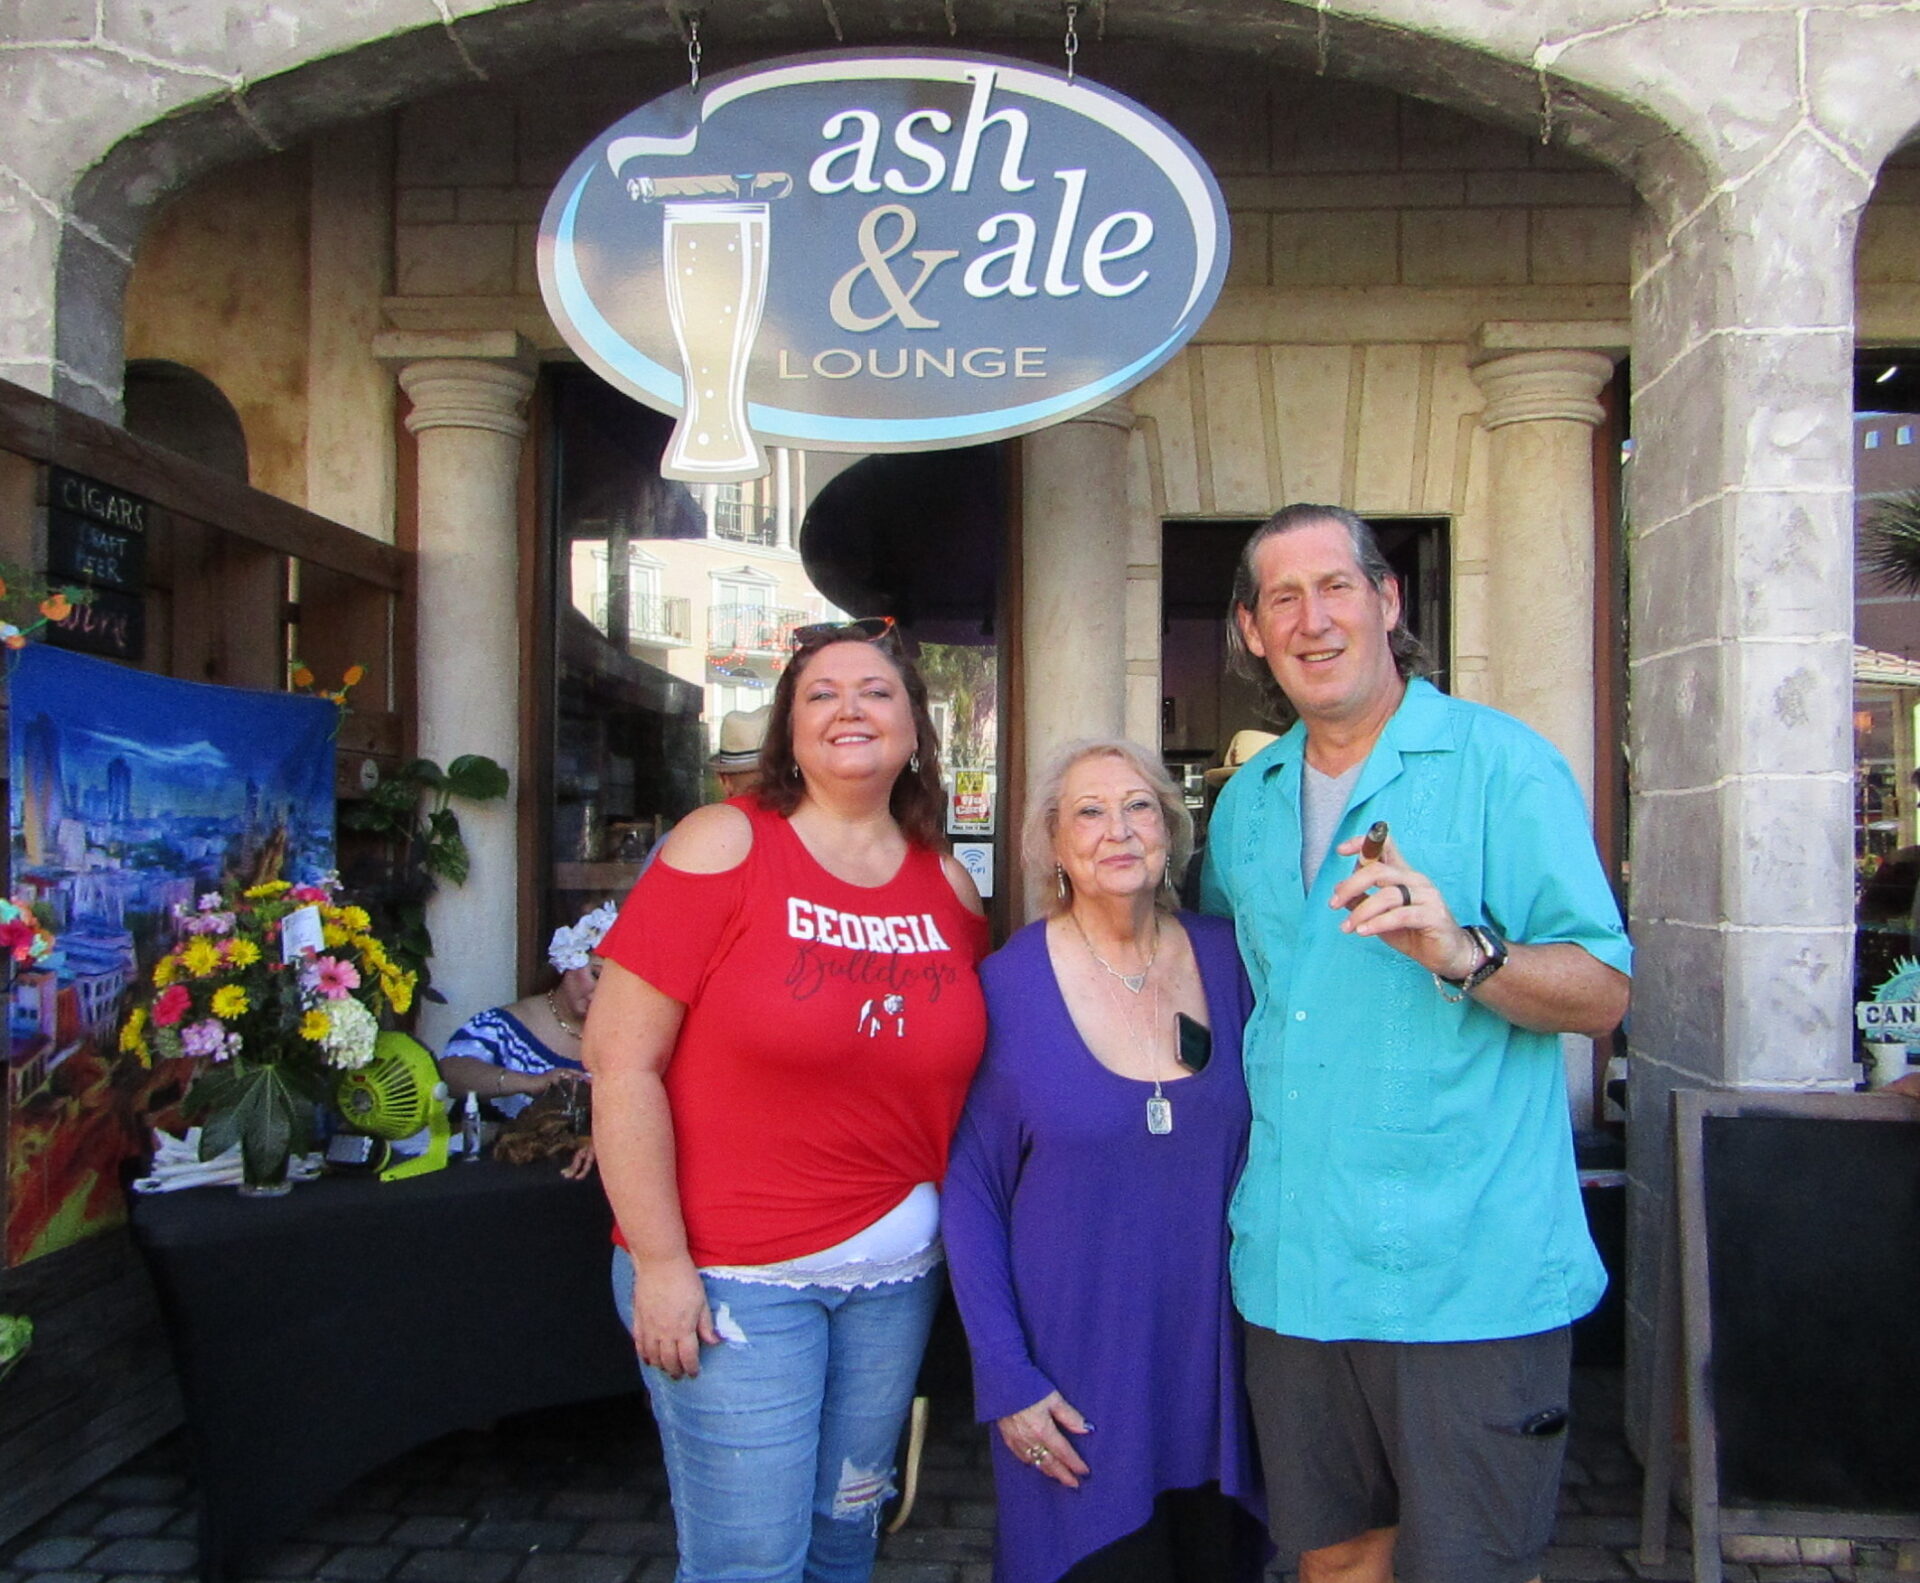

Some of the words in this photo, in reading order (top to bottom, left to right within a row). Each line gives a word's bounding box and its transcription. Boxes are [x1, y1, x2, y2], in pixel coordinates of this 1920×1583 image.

[808, 66, 1035, 195] ash
[829, 203, 959, 333] &
[962, 169, 1155, 298] ale
[778, 346, 1048, 380] LOUNGE
[63, 478, 144, 533] CIGARS
[787, 896, 952, 955] GEORGIA
[784, 942, 957, 1003] Bulldogs
